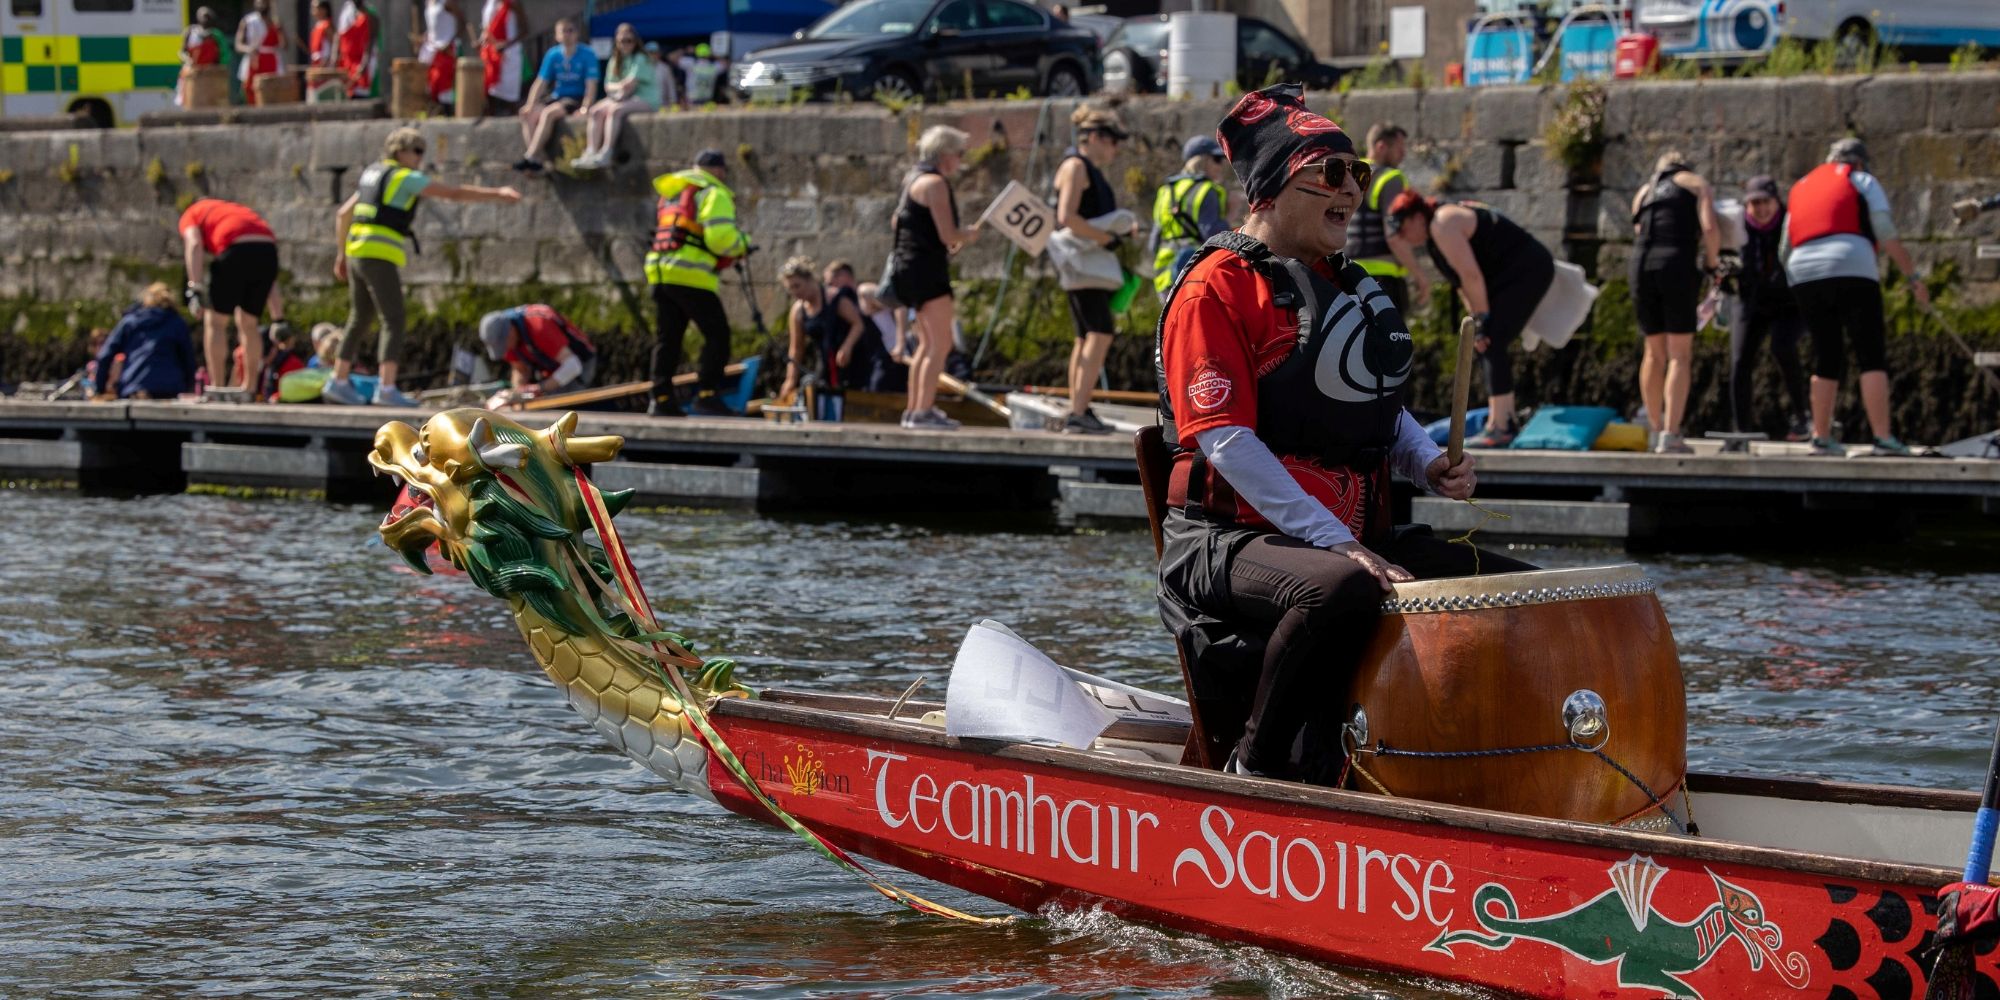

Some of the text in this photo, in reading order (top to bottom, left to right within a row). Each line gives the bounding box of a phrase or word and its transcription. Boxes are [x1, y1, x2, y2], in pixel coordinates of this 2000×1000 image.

[1006, 202, 1044, 238] 50
[1189, 379, 1231, 395] DRAGONS
[1198, 371, 1218, 381] CORK
[864, 748, 1456, 927] Teamhair Saoirse
